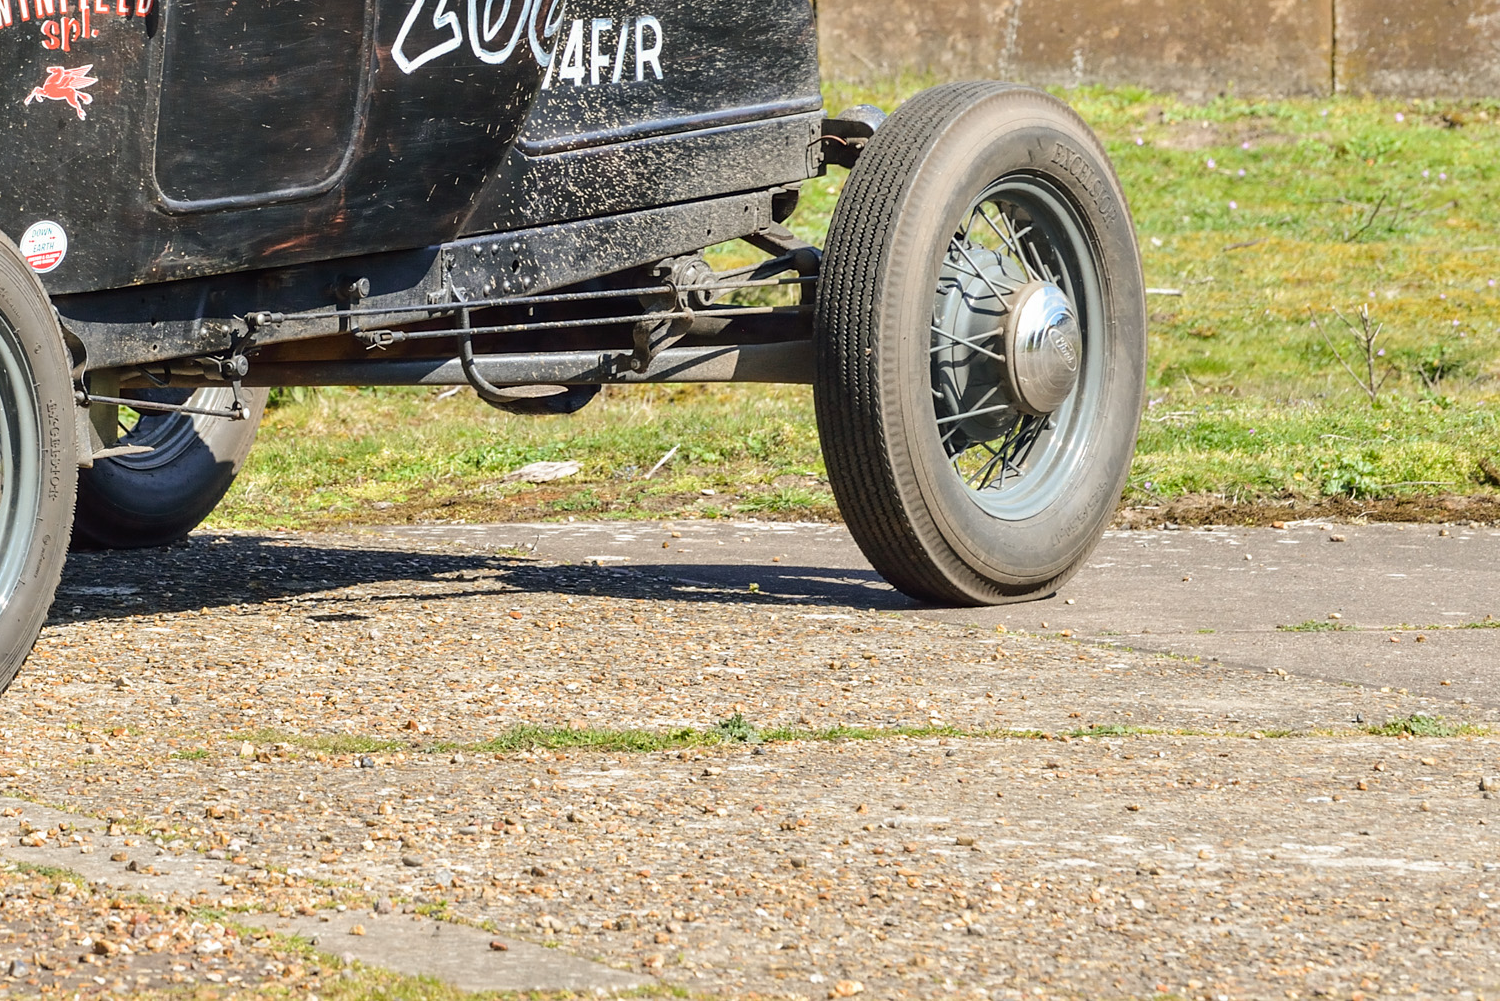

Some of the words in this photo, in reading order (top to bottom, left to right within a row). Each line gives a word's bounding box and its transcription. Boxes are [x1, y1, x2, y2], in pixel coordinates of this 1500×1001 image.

[1051, 142, 1117, 229] EXCELSIOR
[31, 227, 53, 238] DOWN
[33, 242, 55, 253] EARTH
